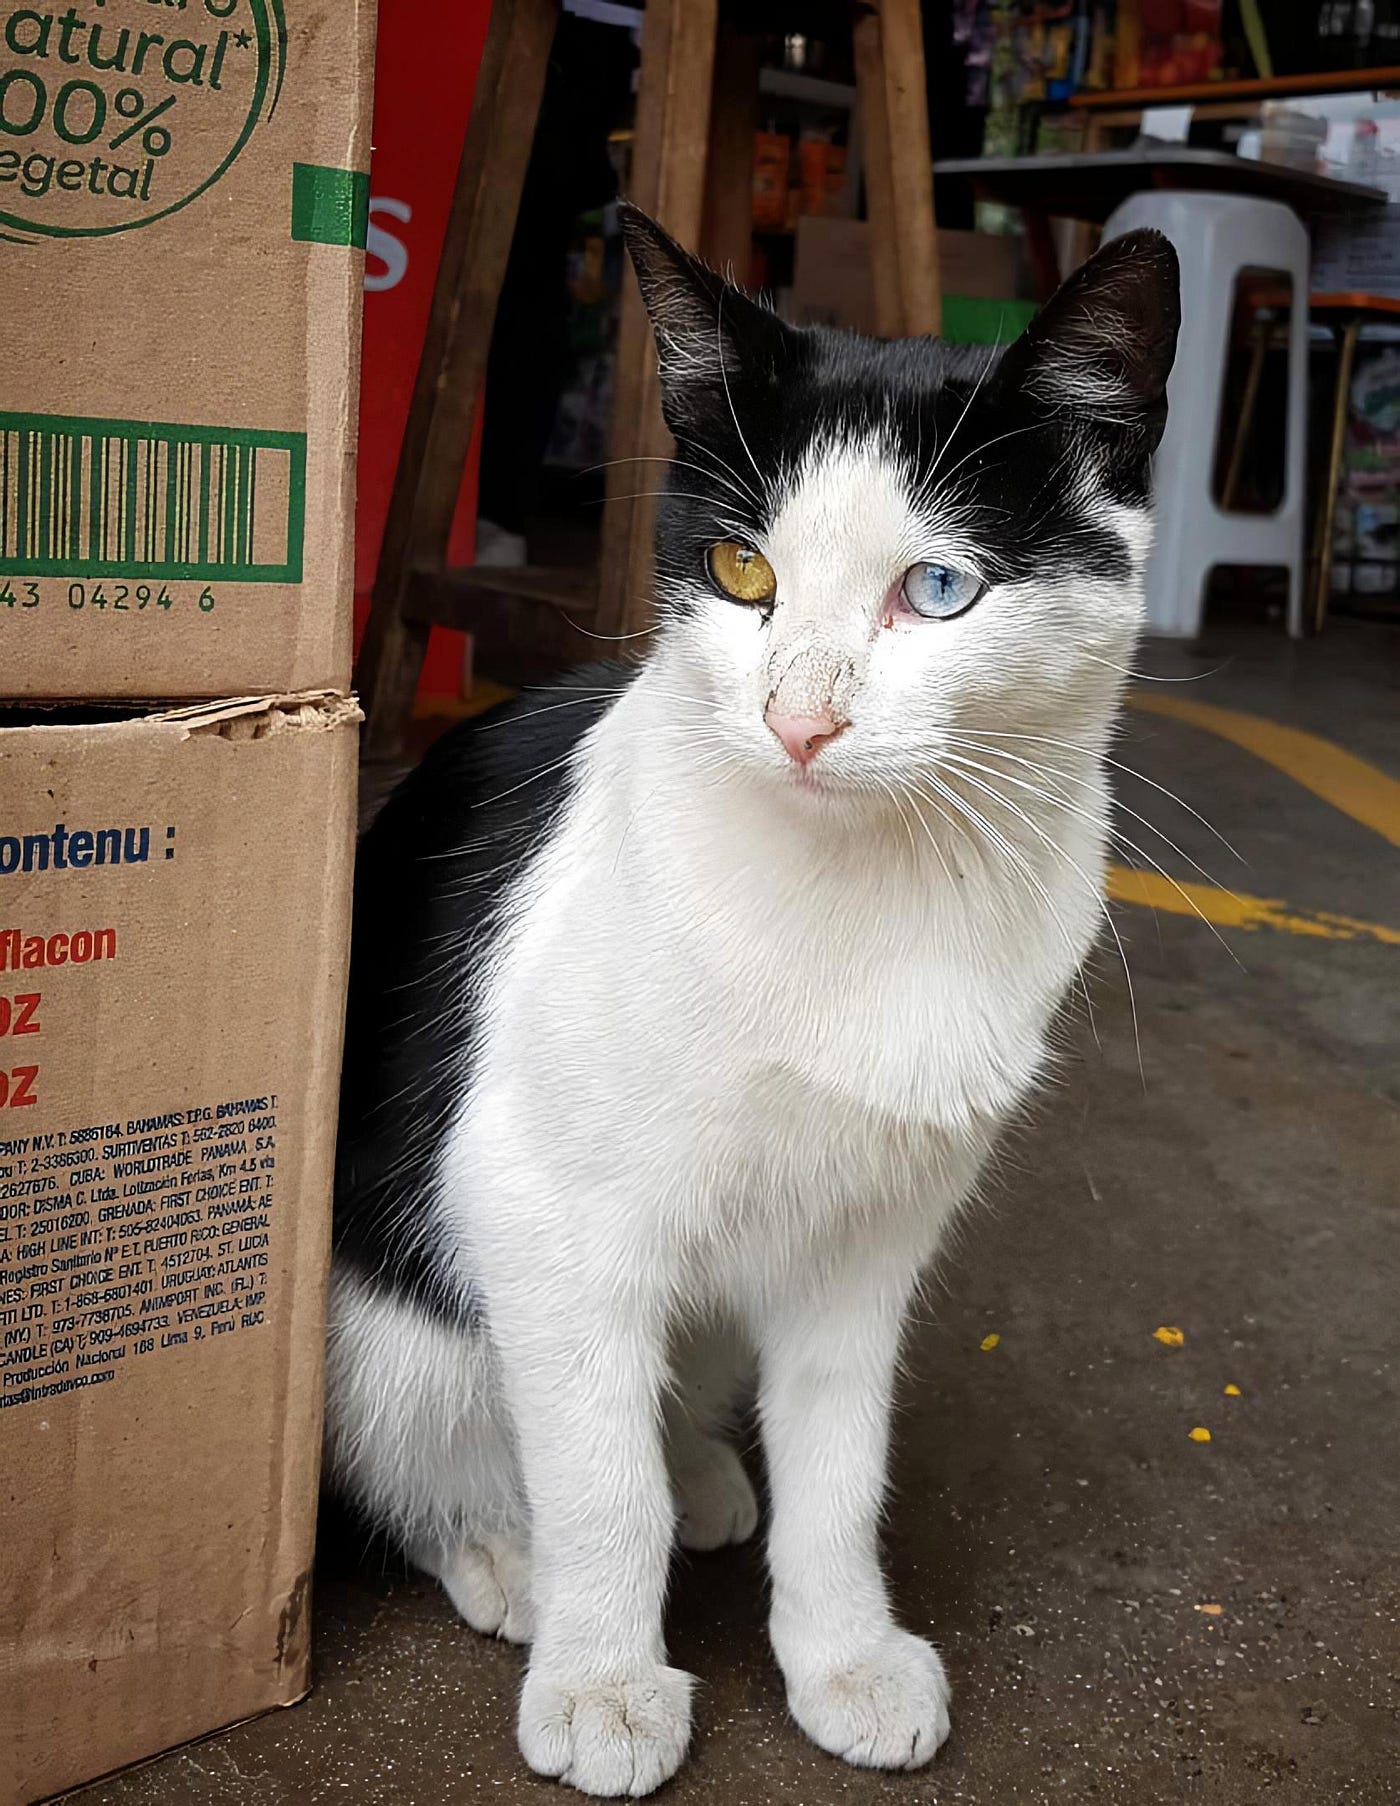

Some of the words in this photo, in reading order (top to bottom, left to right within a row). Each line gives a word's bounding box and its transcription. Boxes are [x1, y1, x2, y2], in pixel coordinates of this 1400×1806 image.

[0, 69, 177, 156] 00%
[0, 150, 154, 200] egetal
[0, 581, 39, 608] 43
[68, 583, 172, 610] 04294
[199, 586, 215, 612] 6
[0, 824, 149, 874] ontenu
[0, 928, 116, 970] flacon
[0, 1202, 30, 1220] DOR:
[160, 1191, 192, 1210] FIRST
[51, 1234, 78, 1252] LINE
[144, 1231, 187, 1254] PUERTO
[30, 1278, 65, 1298] FIRST
